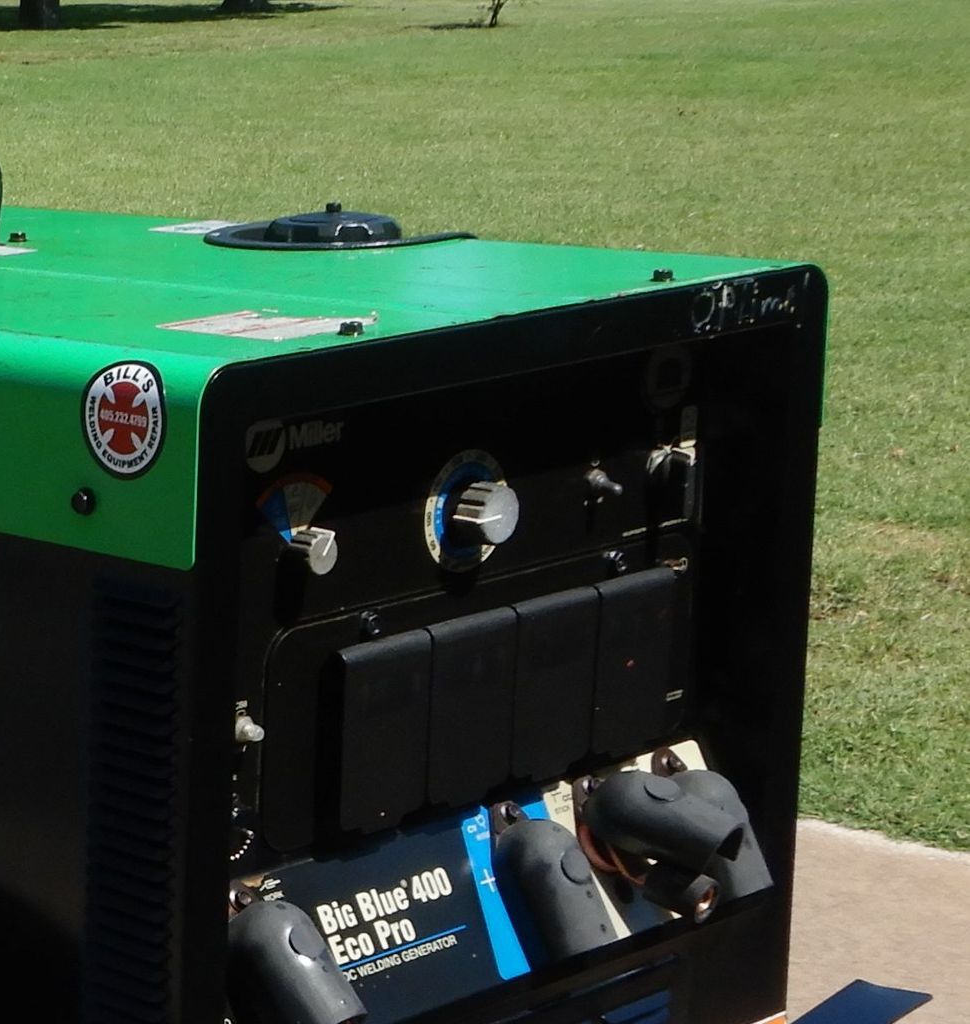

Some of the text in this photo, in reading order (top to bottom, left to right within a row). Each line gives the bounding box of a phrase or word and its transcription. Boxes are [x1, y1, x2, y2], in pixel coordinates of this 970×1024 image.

[103, 367, 154, 393] BILL'S
[88, 396, 158, 469] WELDING EQUIPMENT REPAIR
[289, 420, 344, 450] Miller
[411, 867, 453, 903] 400
[327, 918, 417, 965] Eco Pro
[358, 955, 402, 977] WELDING
[401, 935, 458, 963] GENERATOR
